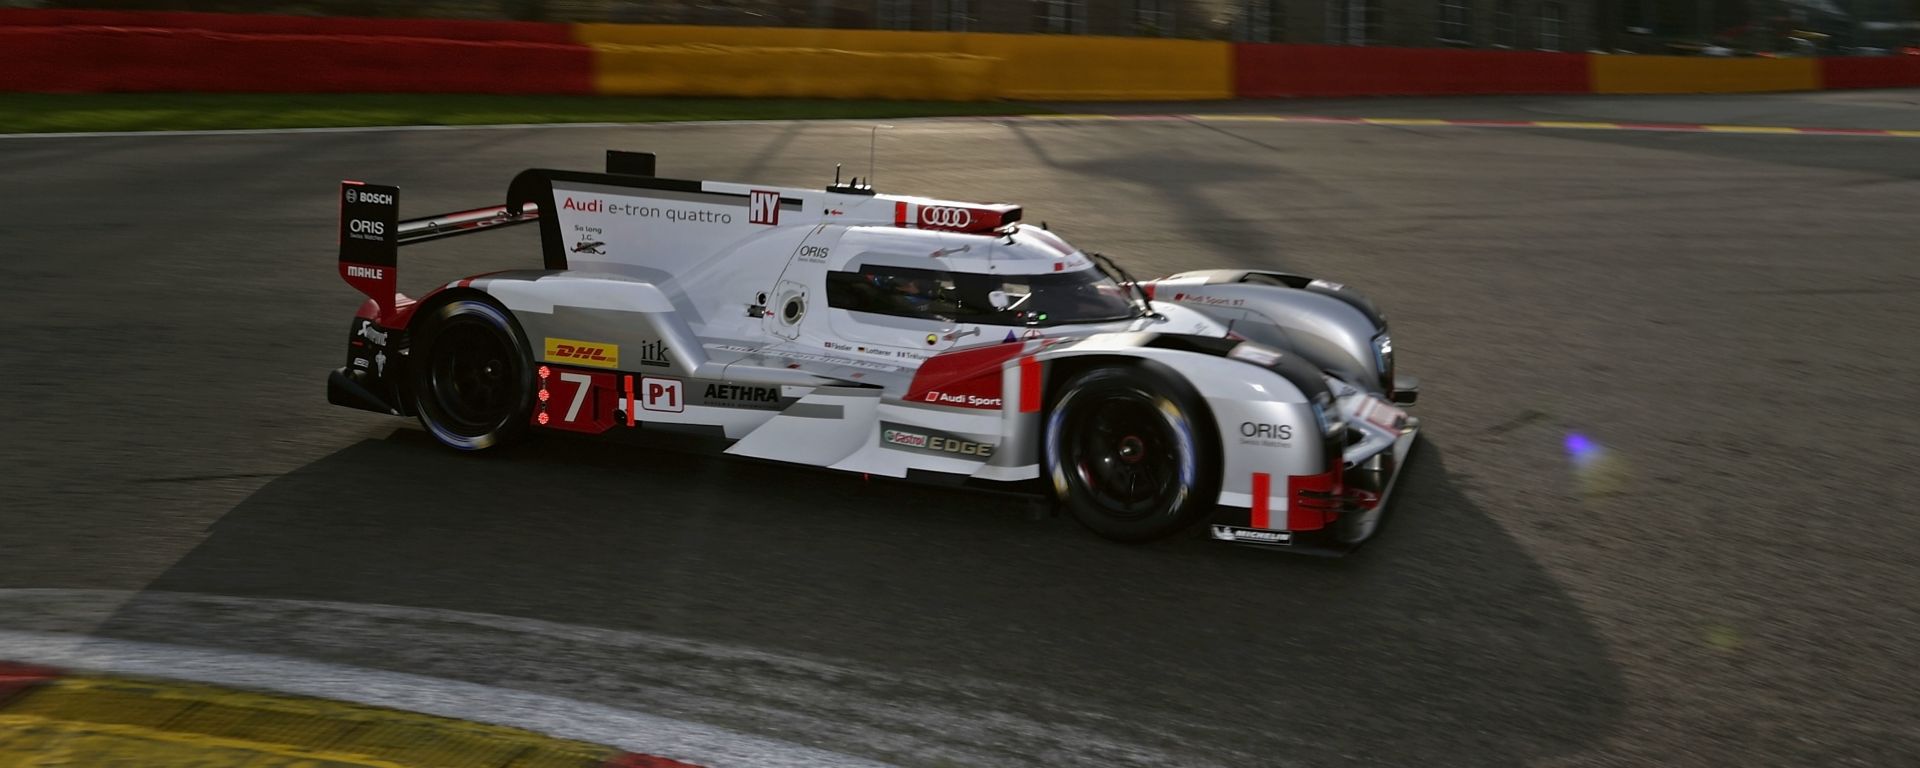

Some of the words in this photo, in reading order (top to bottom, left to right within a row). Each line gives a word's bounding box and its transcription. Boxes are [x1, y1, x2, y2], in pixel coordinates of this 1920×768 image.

[359, 192, 393, 205] BOSCH
[750, 191, 779, 224] HY
[563, 196, 603, 213] Audi
[608, 203, 660, 218] e-tron
[665, 207, 732, 224] quattro
[350, 219, 384, 235] ORIS
[585, 226, 603, 234] long
[799, 245, 829, 259] ORIS
[347, 265, 383, 280] MAHLE
[555, 344, 607, 361] DHL
[641, 339, 670, 361] itk
[560, 372, 592, 422] 7
[648, 383, 676, 407] P1
[704, 383, 779, 403] AETHRA
[940, 393, 966, 403] Audi
[968, 395, 1002, 406] Sport
[1240, 421, 1293, 440] ORIS
[894, 432, 925, 446] Castrol
[928, 436, 993, 456] EDGE
[1235, 529, 1290, 540] MICHELIN
